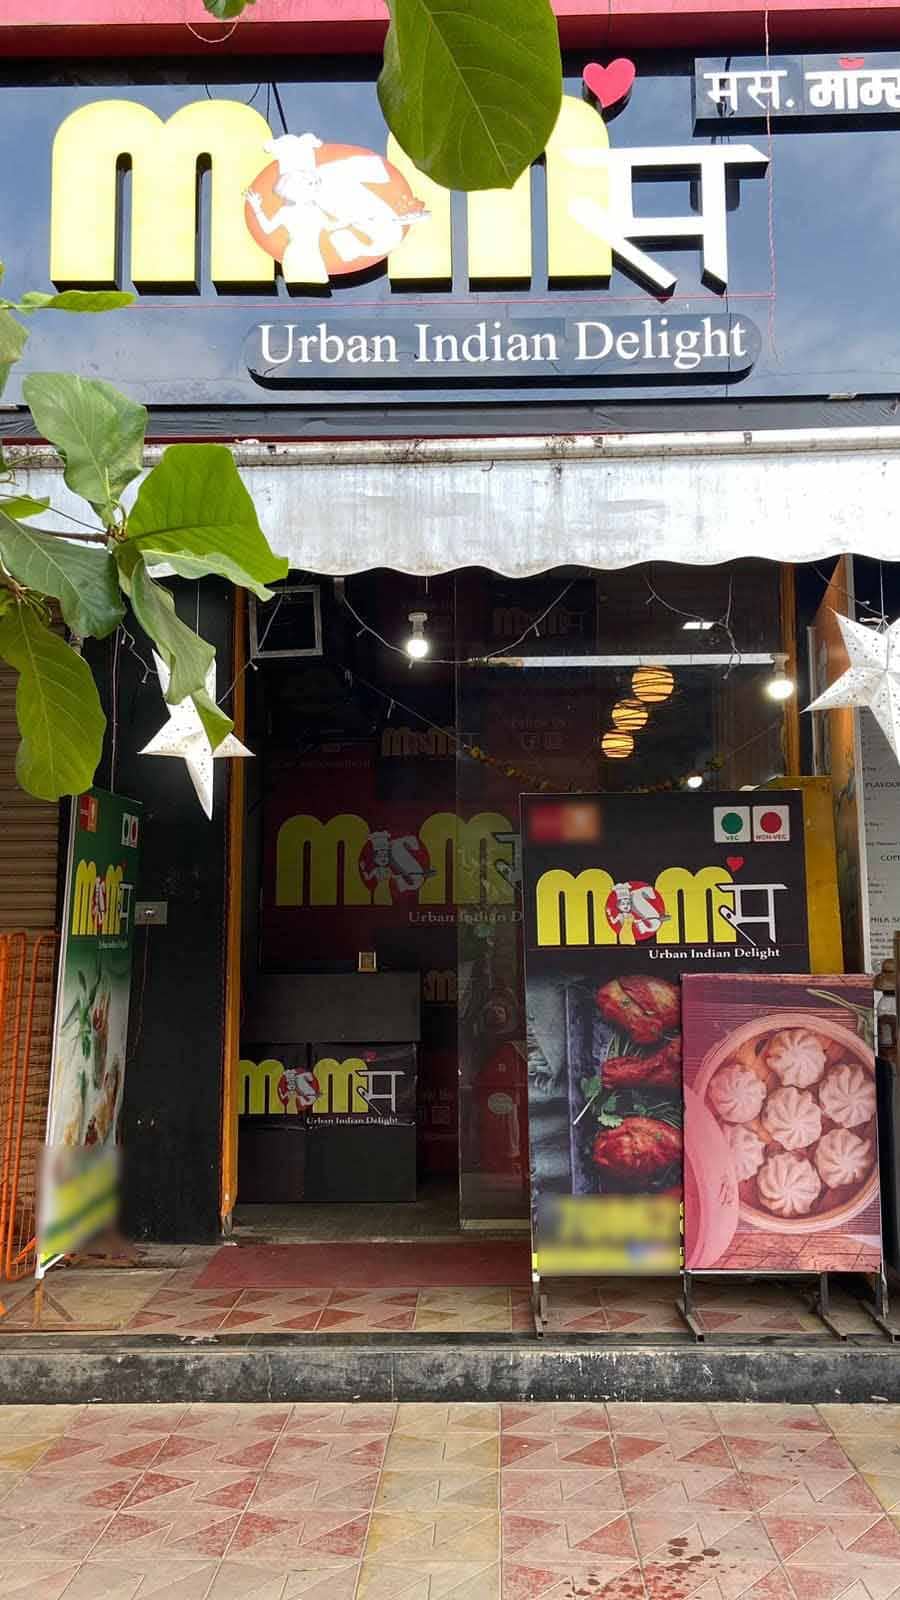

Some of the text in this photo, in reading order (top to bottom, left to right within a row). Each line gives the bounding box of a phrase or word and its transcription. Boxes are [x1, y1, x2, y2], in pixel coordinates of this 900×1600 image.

[258, 317, 747, 369] Urban Indian Delight
[649, 947, 780, 960] Urban Indian Delight
[306, 1116, 398, 1126] Urban Indian Delight
